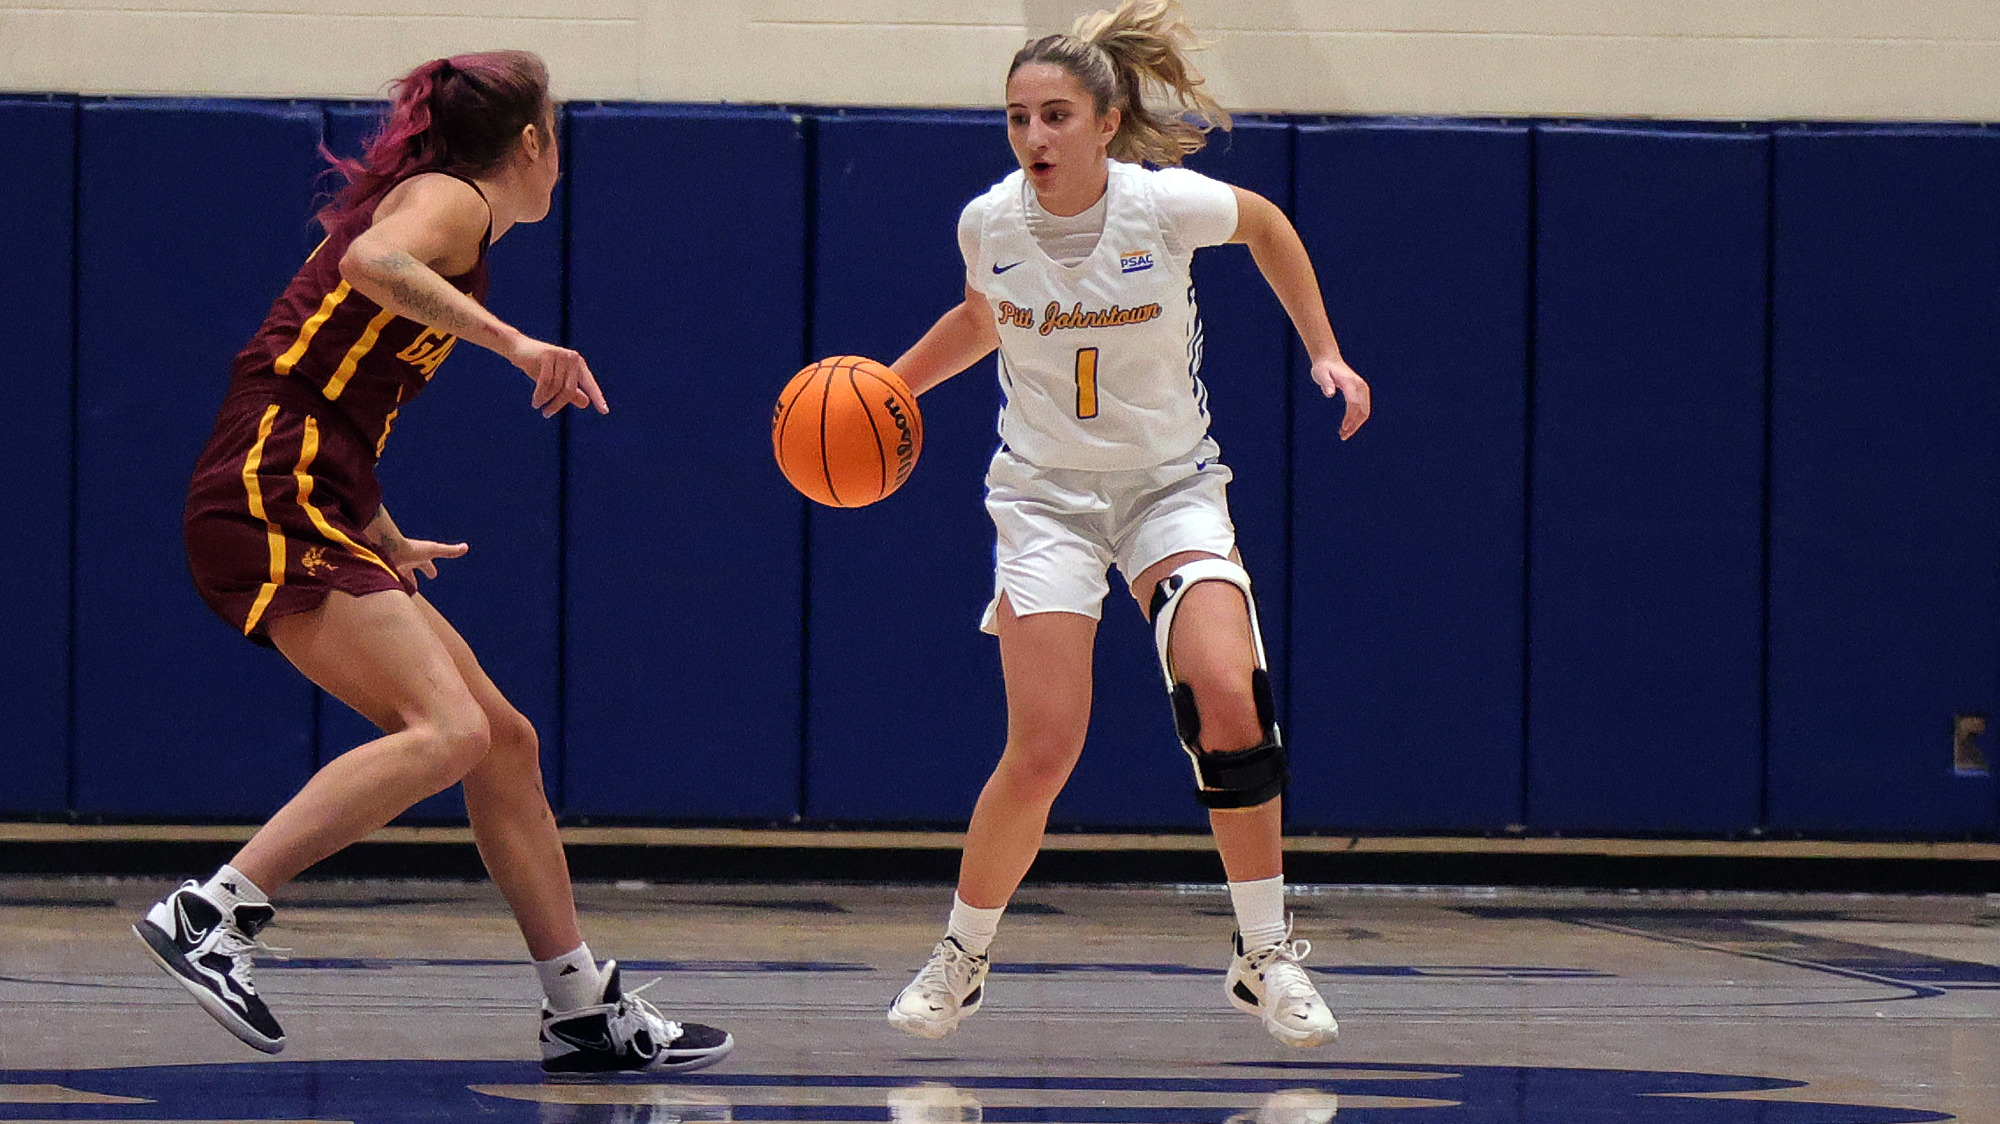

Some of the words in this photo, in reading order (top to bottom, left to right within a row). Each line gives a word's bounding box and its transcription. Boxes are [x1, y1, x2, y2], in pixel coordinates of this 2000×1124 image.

[1120, 253, 1153, 268] PSAC
[999, 301, 1034, 328] Pitt
[1039, 301, 1162, 336] Johnstown
[396, 326, 458, 382] GA
[1075, 347, 1098, 419] 1
